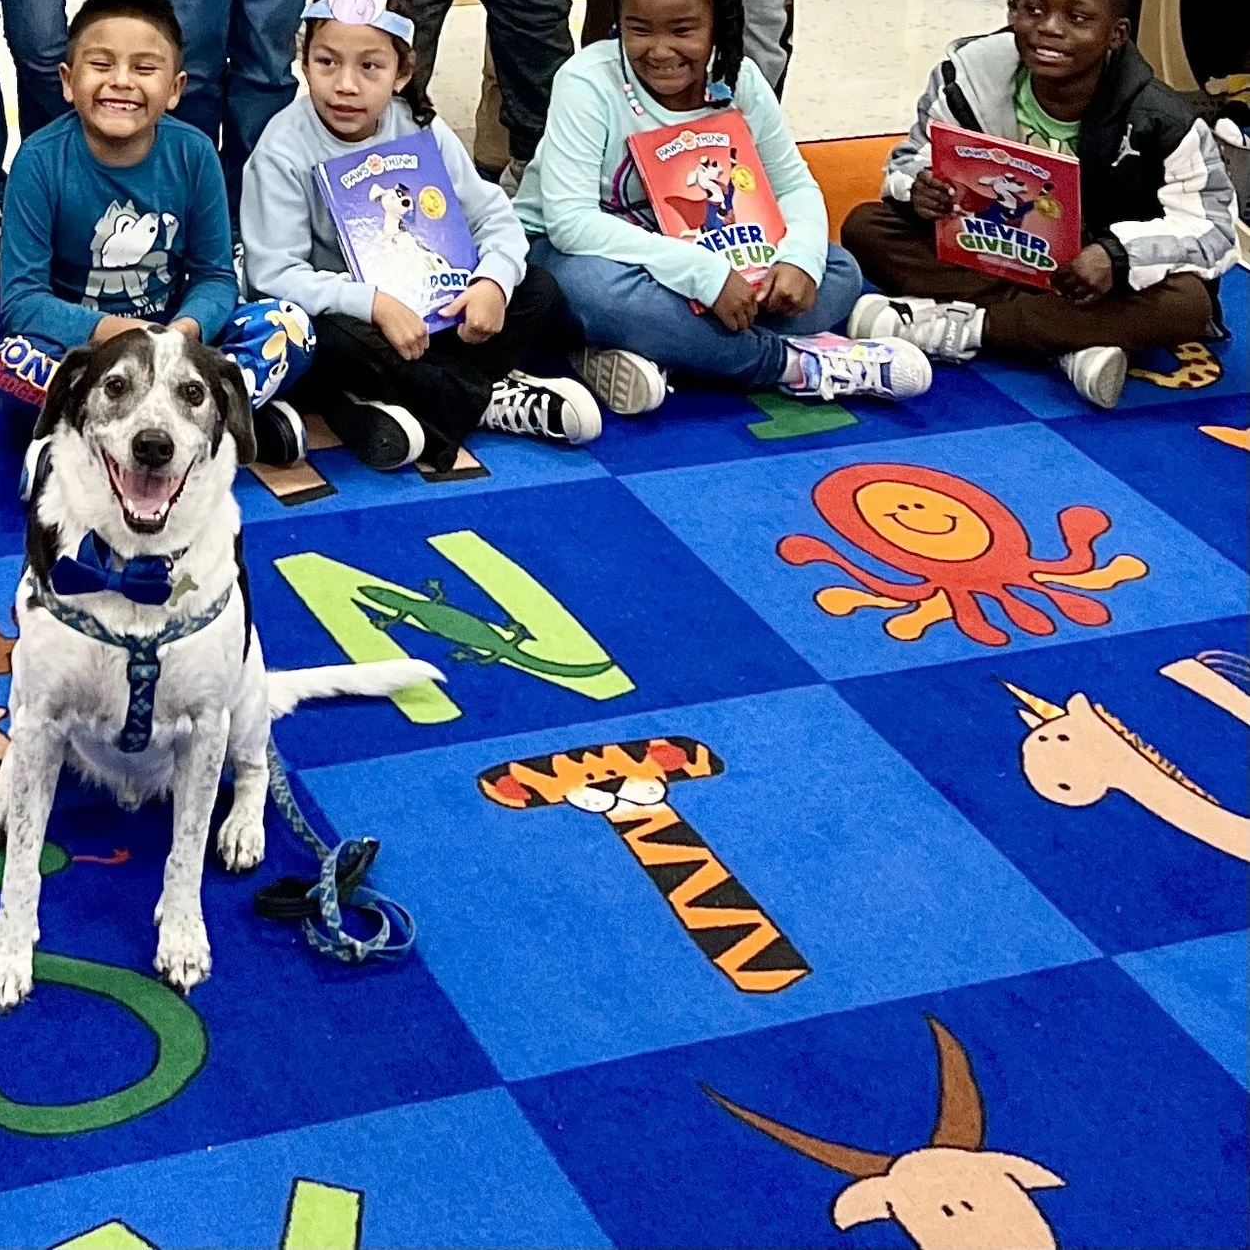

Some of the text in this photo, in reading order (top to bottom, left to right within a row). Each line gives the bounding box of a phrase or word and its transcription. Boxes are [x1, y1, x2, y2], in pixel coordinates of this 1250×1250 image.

[343, 166, 369, 185] PAWS
[964, 218, 1048, 253] NEVER
[748, 245, 776, 263] UP
[959, 234, 1014, 255] GIVE
[1020, 247, 1055, 268] UP
